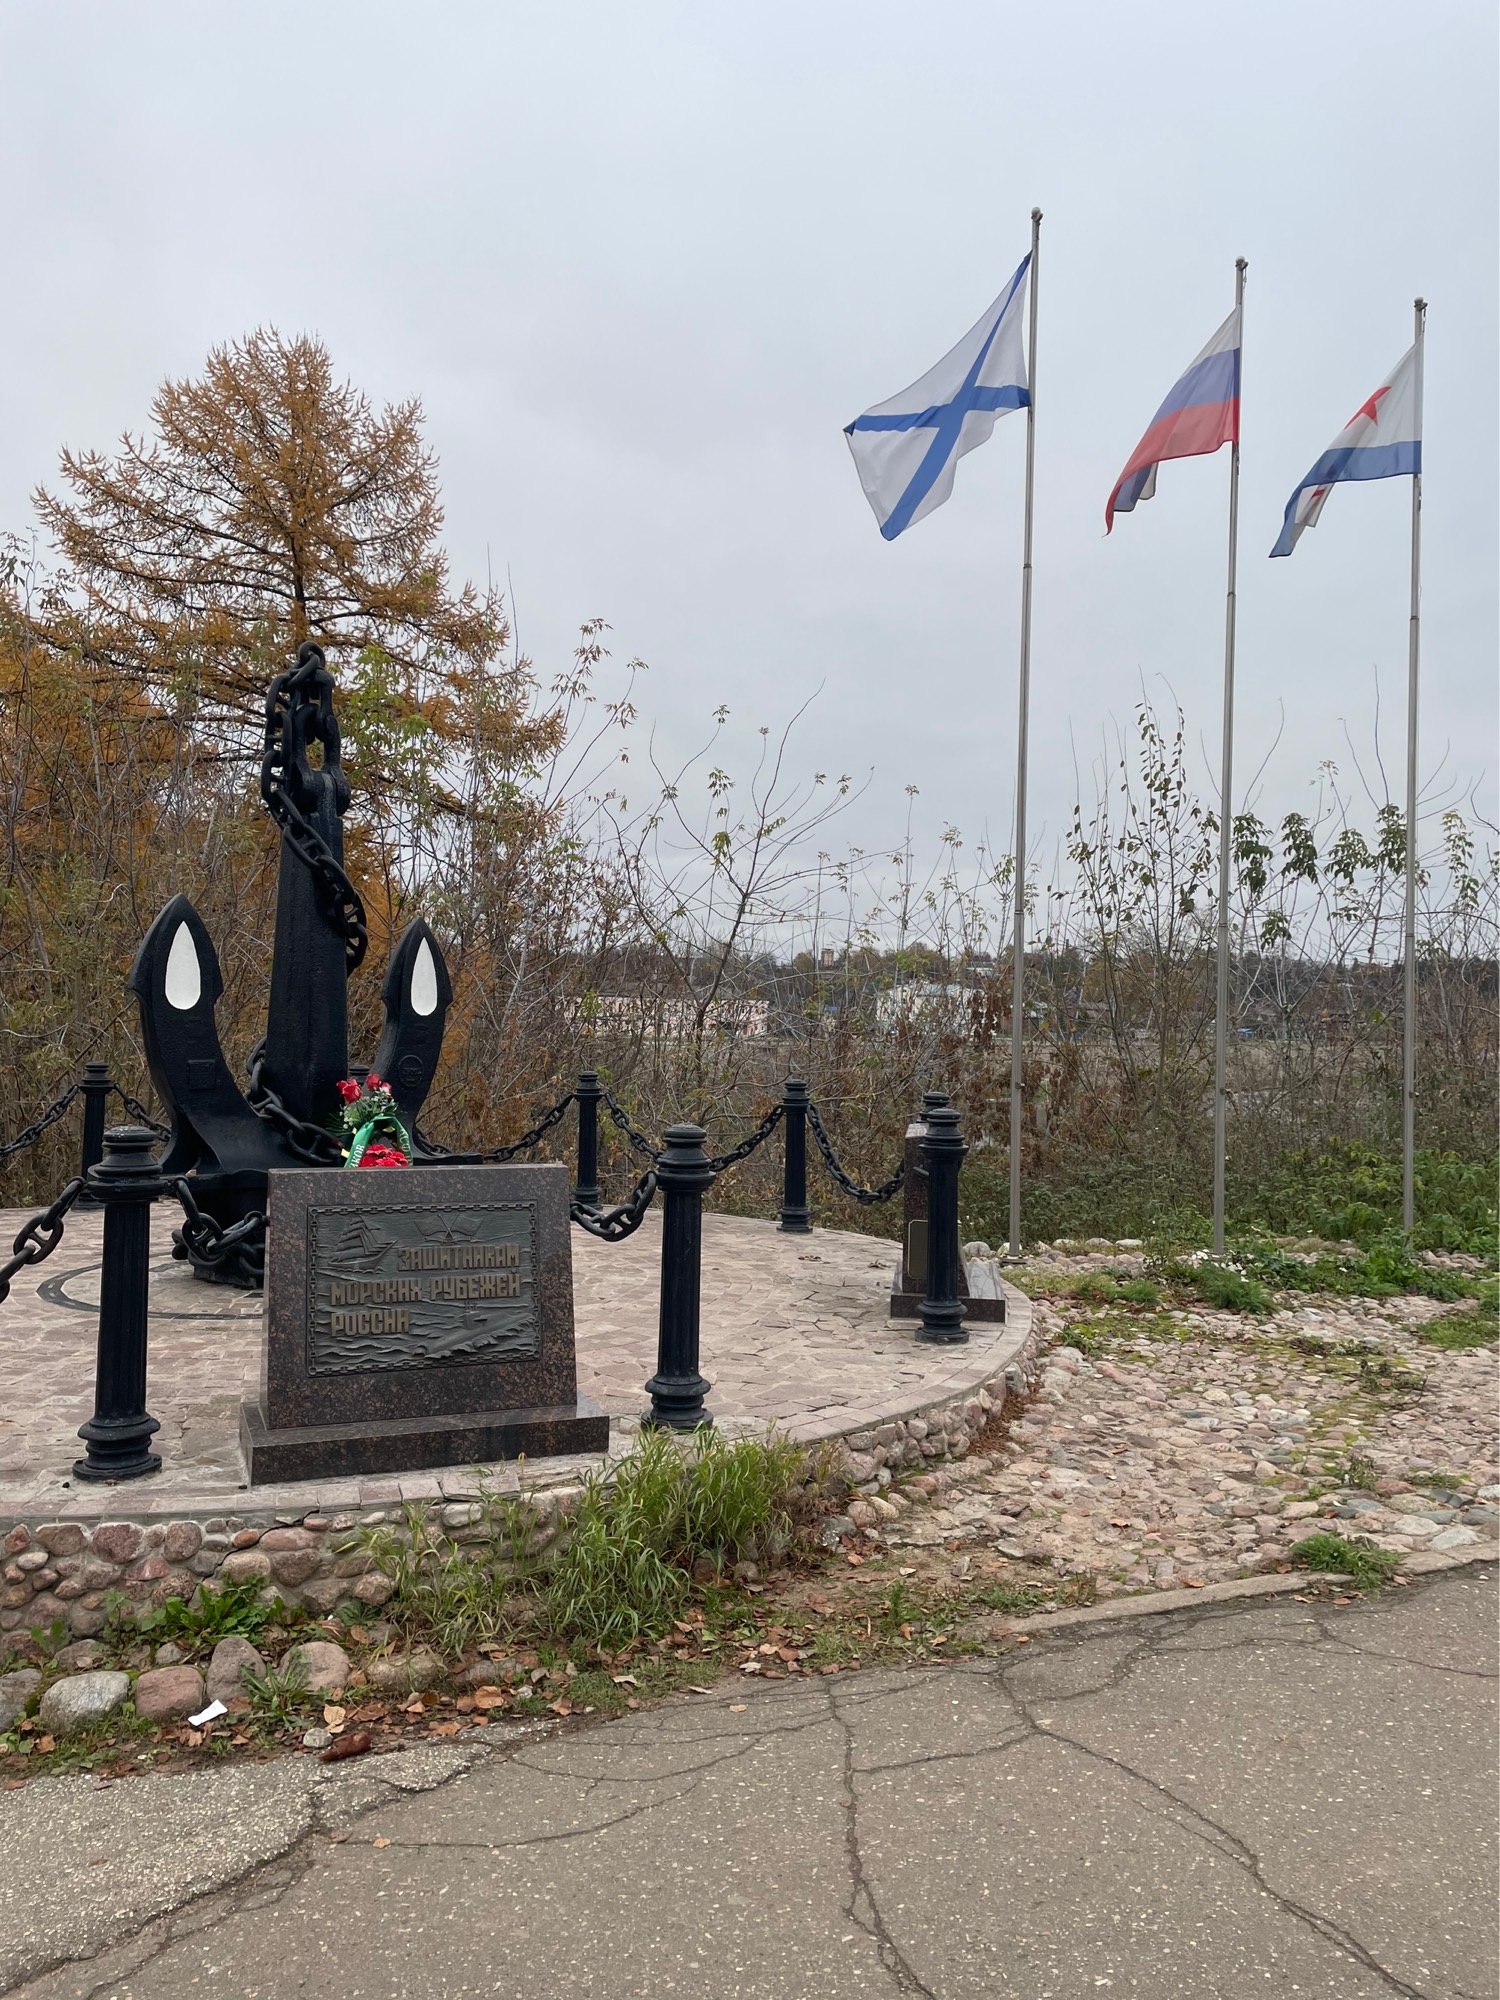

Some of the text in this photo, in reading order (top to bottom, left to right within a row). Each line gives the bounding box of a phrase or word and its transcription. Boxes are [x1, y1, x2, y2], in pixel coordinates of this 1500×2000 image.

[330, 1268, 521, 1306] МОРСКИХ РУБЕЖЕЙ
[331, 1308, 410, 1337] РОССИИ
